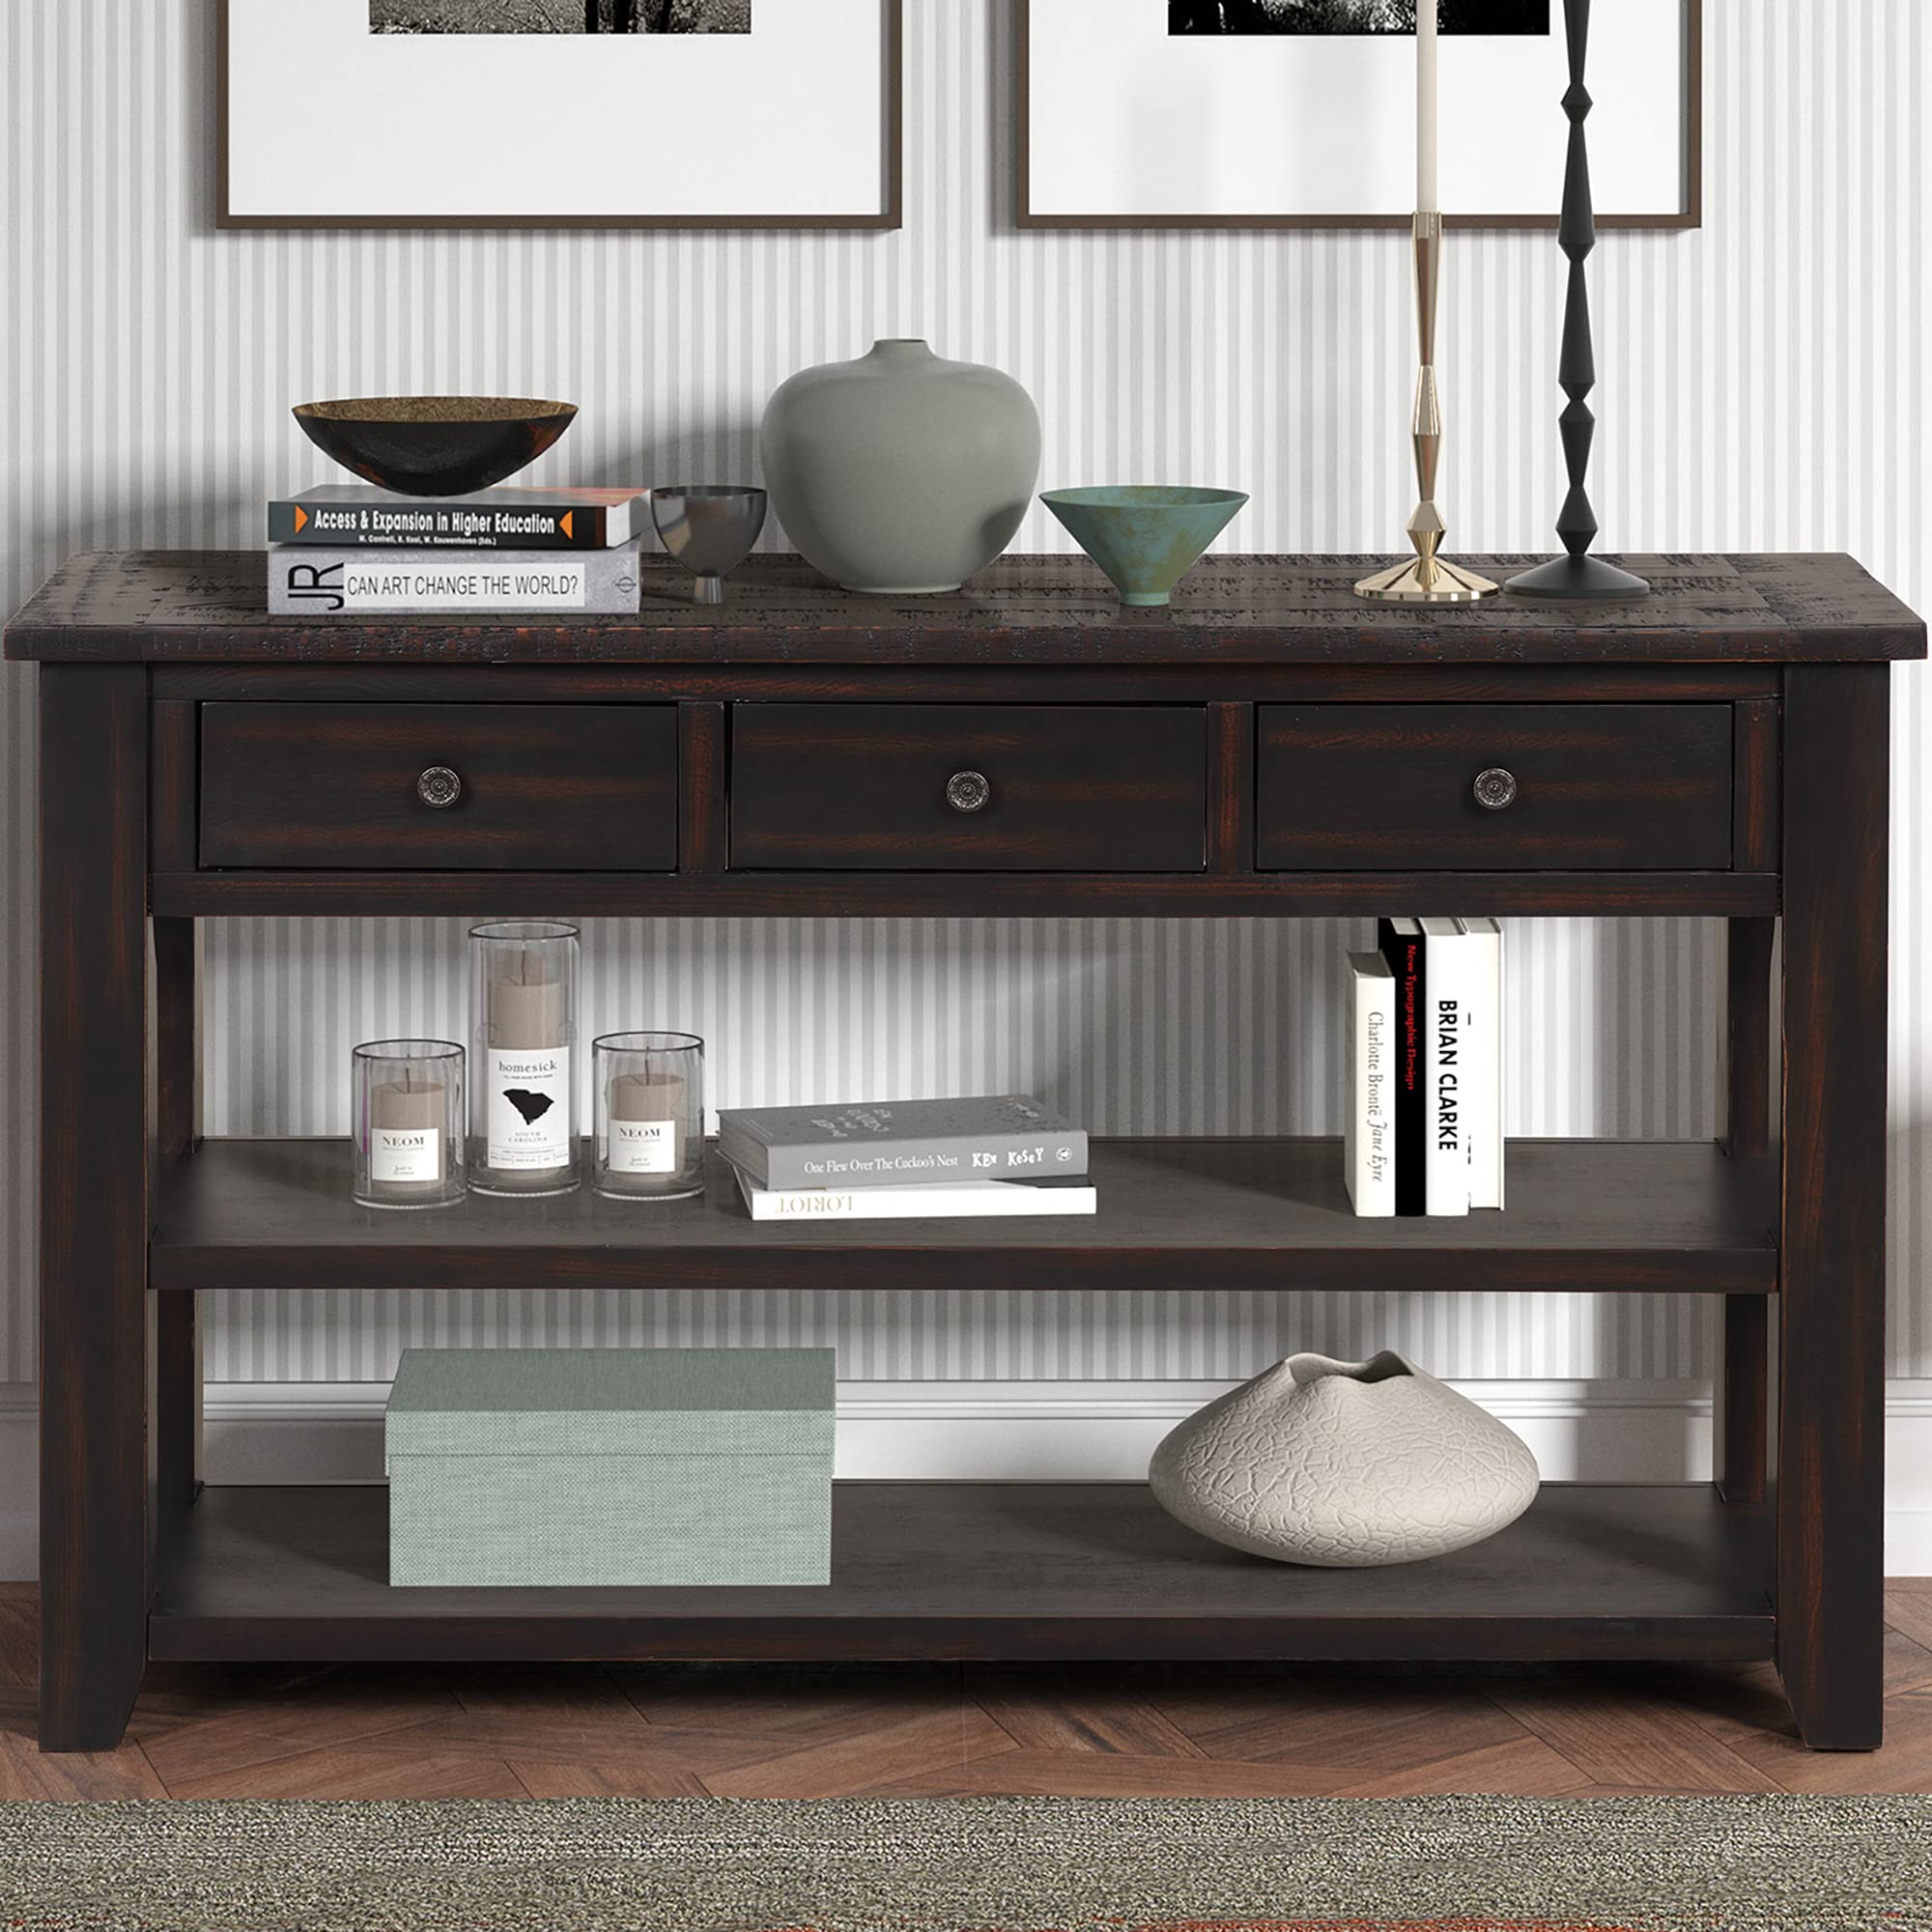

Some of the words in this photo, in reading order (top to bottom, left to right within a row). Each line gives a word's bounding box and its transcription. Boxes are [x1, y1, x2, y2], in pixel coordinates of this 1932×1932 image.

[314, 509, 356, 530] Access
[359, 509, 369, 530] &
[372, 510, 434, 534] Expansion
[437, 511, 448, 531] in
[451, 512, 492, 536] Higher
[495, 512, 555, 534] Education
[288, 562, 344, 611] JR
[347, 576, 379, 596] CAN
[382, 576, 412, 595] ART
[414, 576, 477, 595] CHANGE
[481, 576, 510, 595] THE
[514, 575, 579, 595] WORLD?
[1407, 944, 1417, 973] New
[1405, 974, 1418, 1047] Typographic
[1368, 1011, 1384, 1070] Charlotte
[1438, 1001, 1458, 1065] BRIAN
[498, 1060, 557, 1072] homesick
[1405, 1048, 1417, 1091] Design
[1368, 1074, 1384, 1116] Brontë
[1438, 1073, 1458, 1151] CLARKE
[383, 1136, 424, 1147] NEOM
[618, 1127, 661, 1138] NEOM
[1366, 1119, 1388, 1151] Jane
[804, 1160, 824, 1174] One
[826, 1159, 848, 1173] Flew
[850, 1158, 873, 1172] Over
[874, 1157, 893, 1170] The
[895, 1155, 935, 1169] Cuckoo's
[937, 1154, 958, 1167] Nest
[1366, 1154, 1388, 1182] Eyre
[775, 1196, 852, 1213] LORIOT
